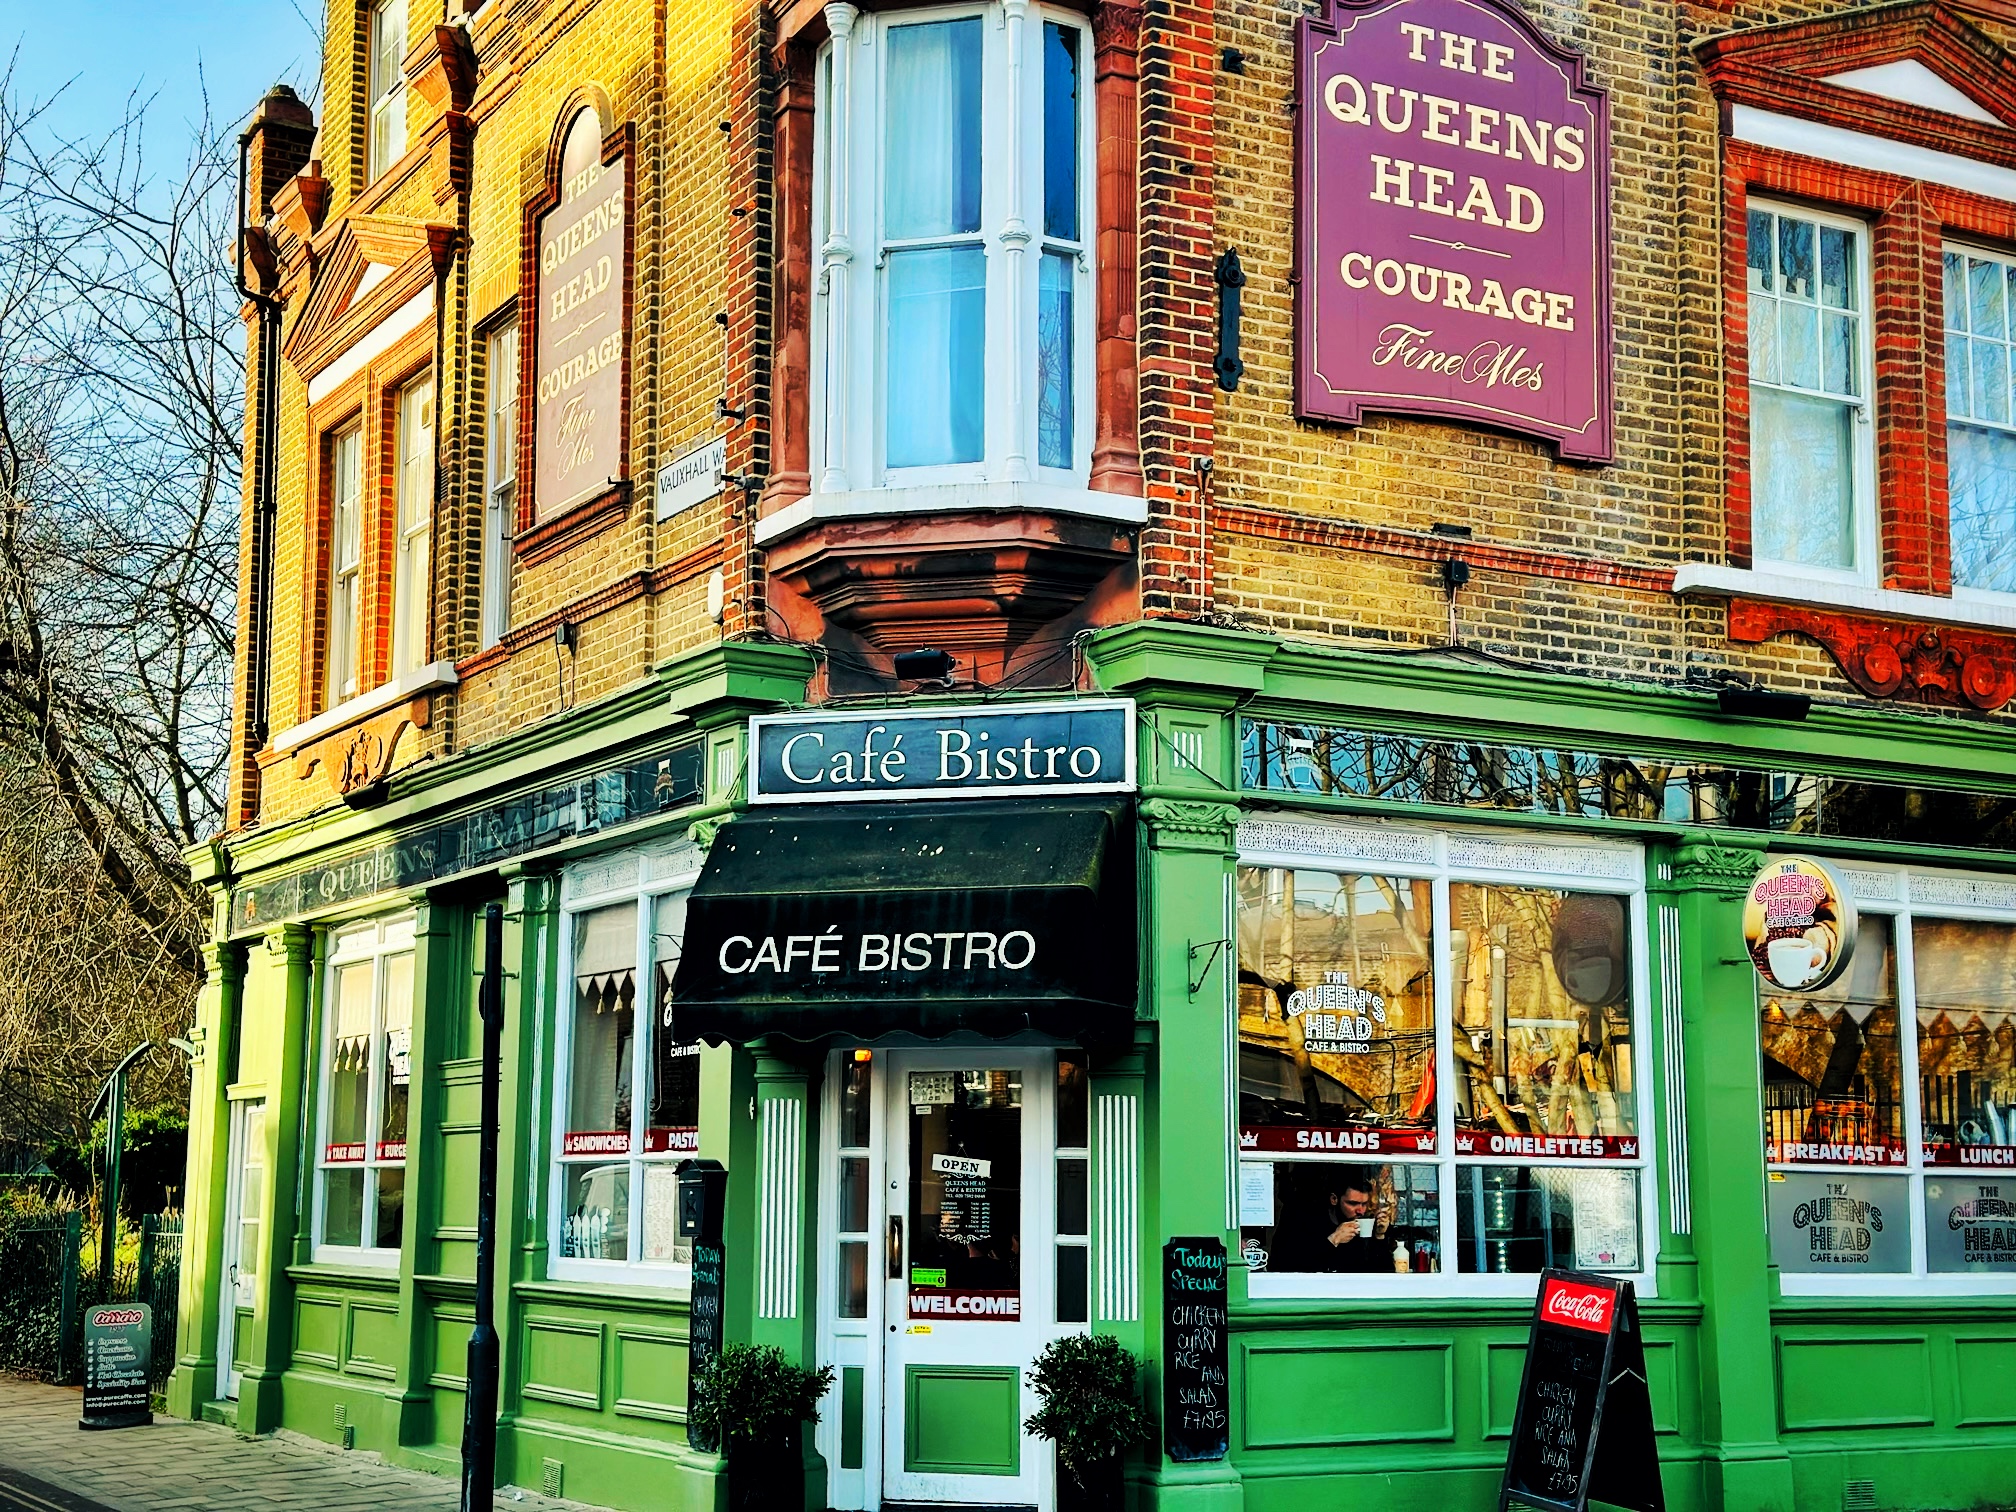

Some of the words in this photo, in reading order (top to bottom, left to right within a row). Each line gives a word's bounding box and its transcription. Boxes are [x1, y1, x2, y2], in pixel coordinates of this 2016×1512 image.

[1400, 21, 1515, 83] THE
[1324, 73, 1586, 173] QUEENS
[565, 159, 602, 206] THE
[1369, 154, 1546, 234] HEAD
[541, 188, 625, 277] QUEENS
[550, 254, 613, 325] HEAD
[1340, 251, 1575, 332] COURAGE
[539, 330, 622, 406] COURAGE
[1372, 323, 1462, 377] Fine
[1460, 340, 1543, 392] Ales
[556, 390, 597, 448] Fine
[557, 433, 595, 482] Ales
[660, 454, 709, 494] VAUXHALL
[781, 727, 906, 784] Café
[936, 729, 1102, 781] Bistro
[318, 840, 436, 903] QUEENS
[1780, 864, 1798, 873] THE
[1755, 874, 1826, 904] QUEEN'S
[1767, 896, 1817, 918] HEAD
[719, 925, 843, 974] CAFÉ
[858, 931, 1036, 972] BISTRO
[1324, 972, 1348, 984] THE
[1287, 985, 1386, 1023] QUEEN'S
[1305, 1014, 1373, 1041] HEAD
[1304, 1041, 1328, 1052] CAFE
[1330, 1041, 1338, 1052] &
[1339, 1042, 1370, 1054] BISTRO
[573, 1135, 628, 1152] SANDWICHES
[668, 1132, 698, 1150] PASTA
[1296, 1131, 1380, 1150] SALADS
[1490, 1136, 1604, 1156] OMELETTES
[1783, 1143, 1886, 1162] BREAKFAST
[332, 1149, 347, 1161] TAKE
[347, 1147, 364, 1159] AWAY
[941, 1159, 980, 1173] OPEN
[1960, 1149, 2014, 1164] LUNCH
[1978, 1186, 1999, 1197] THE
[1793, 1198, 1884, 1233] QUEEN'S
[1810, 1226, 1871, 1251] HEAD
[1809, 1253, 1832, 1263] CAFE
[1833, 1254, 1840, 1263] &
[1841, 1254, 1869, 1263] BISTRO
[1964, 1253, 1985, 1263] CAFE
[1986, 1253, 1993, 1263] &
[910, 1295, 1020, 1315] WELCOME
[1173, 1306, 1225, 1326] CHICKEN
[1549, 1289, 1609, 1323] Coca-Cola
[1175, 1351, 1200, 1370] RICE
[1201, 1366, 1225, 1385] AND
[85, 1393, 147, 1402] www.purecaffe.com
[85, 1398, 146, 1408] info@purecaffe.com
[1180, 1384, 1217, 1408] SALAD
